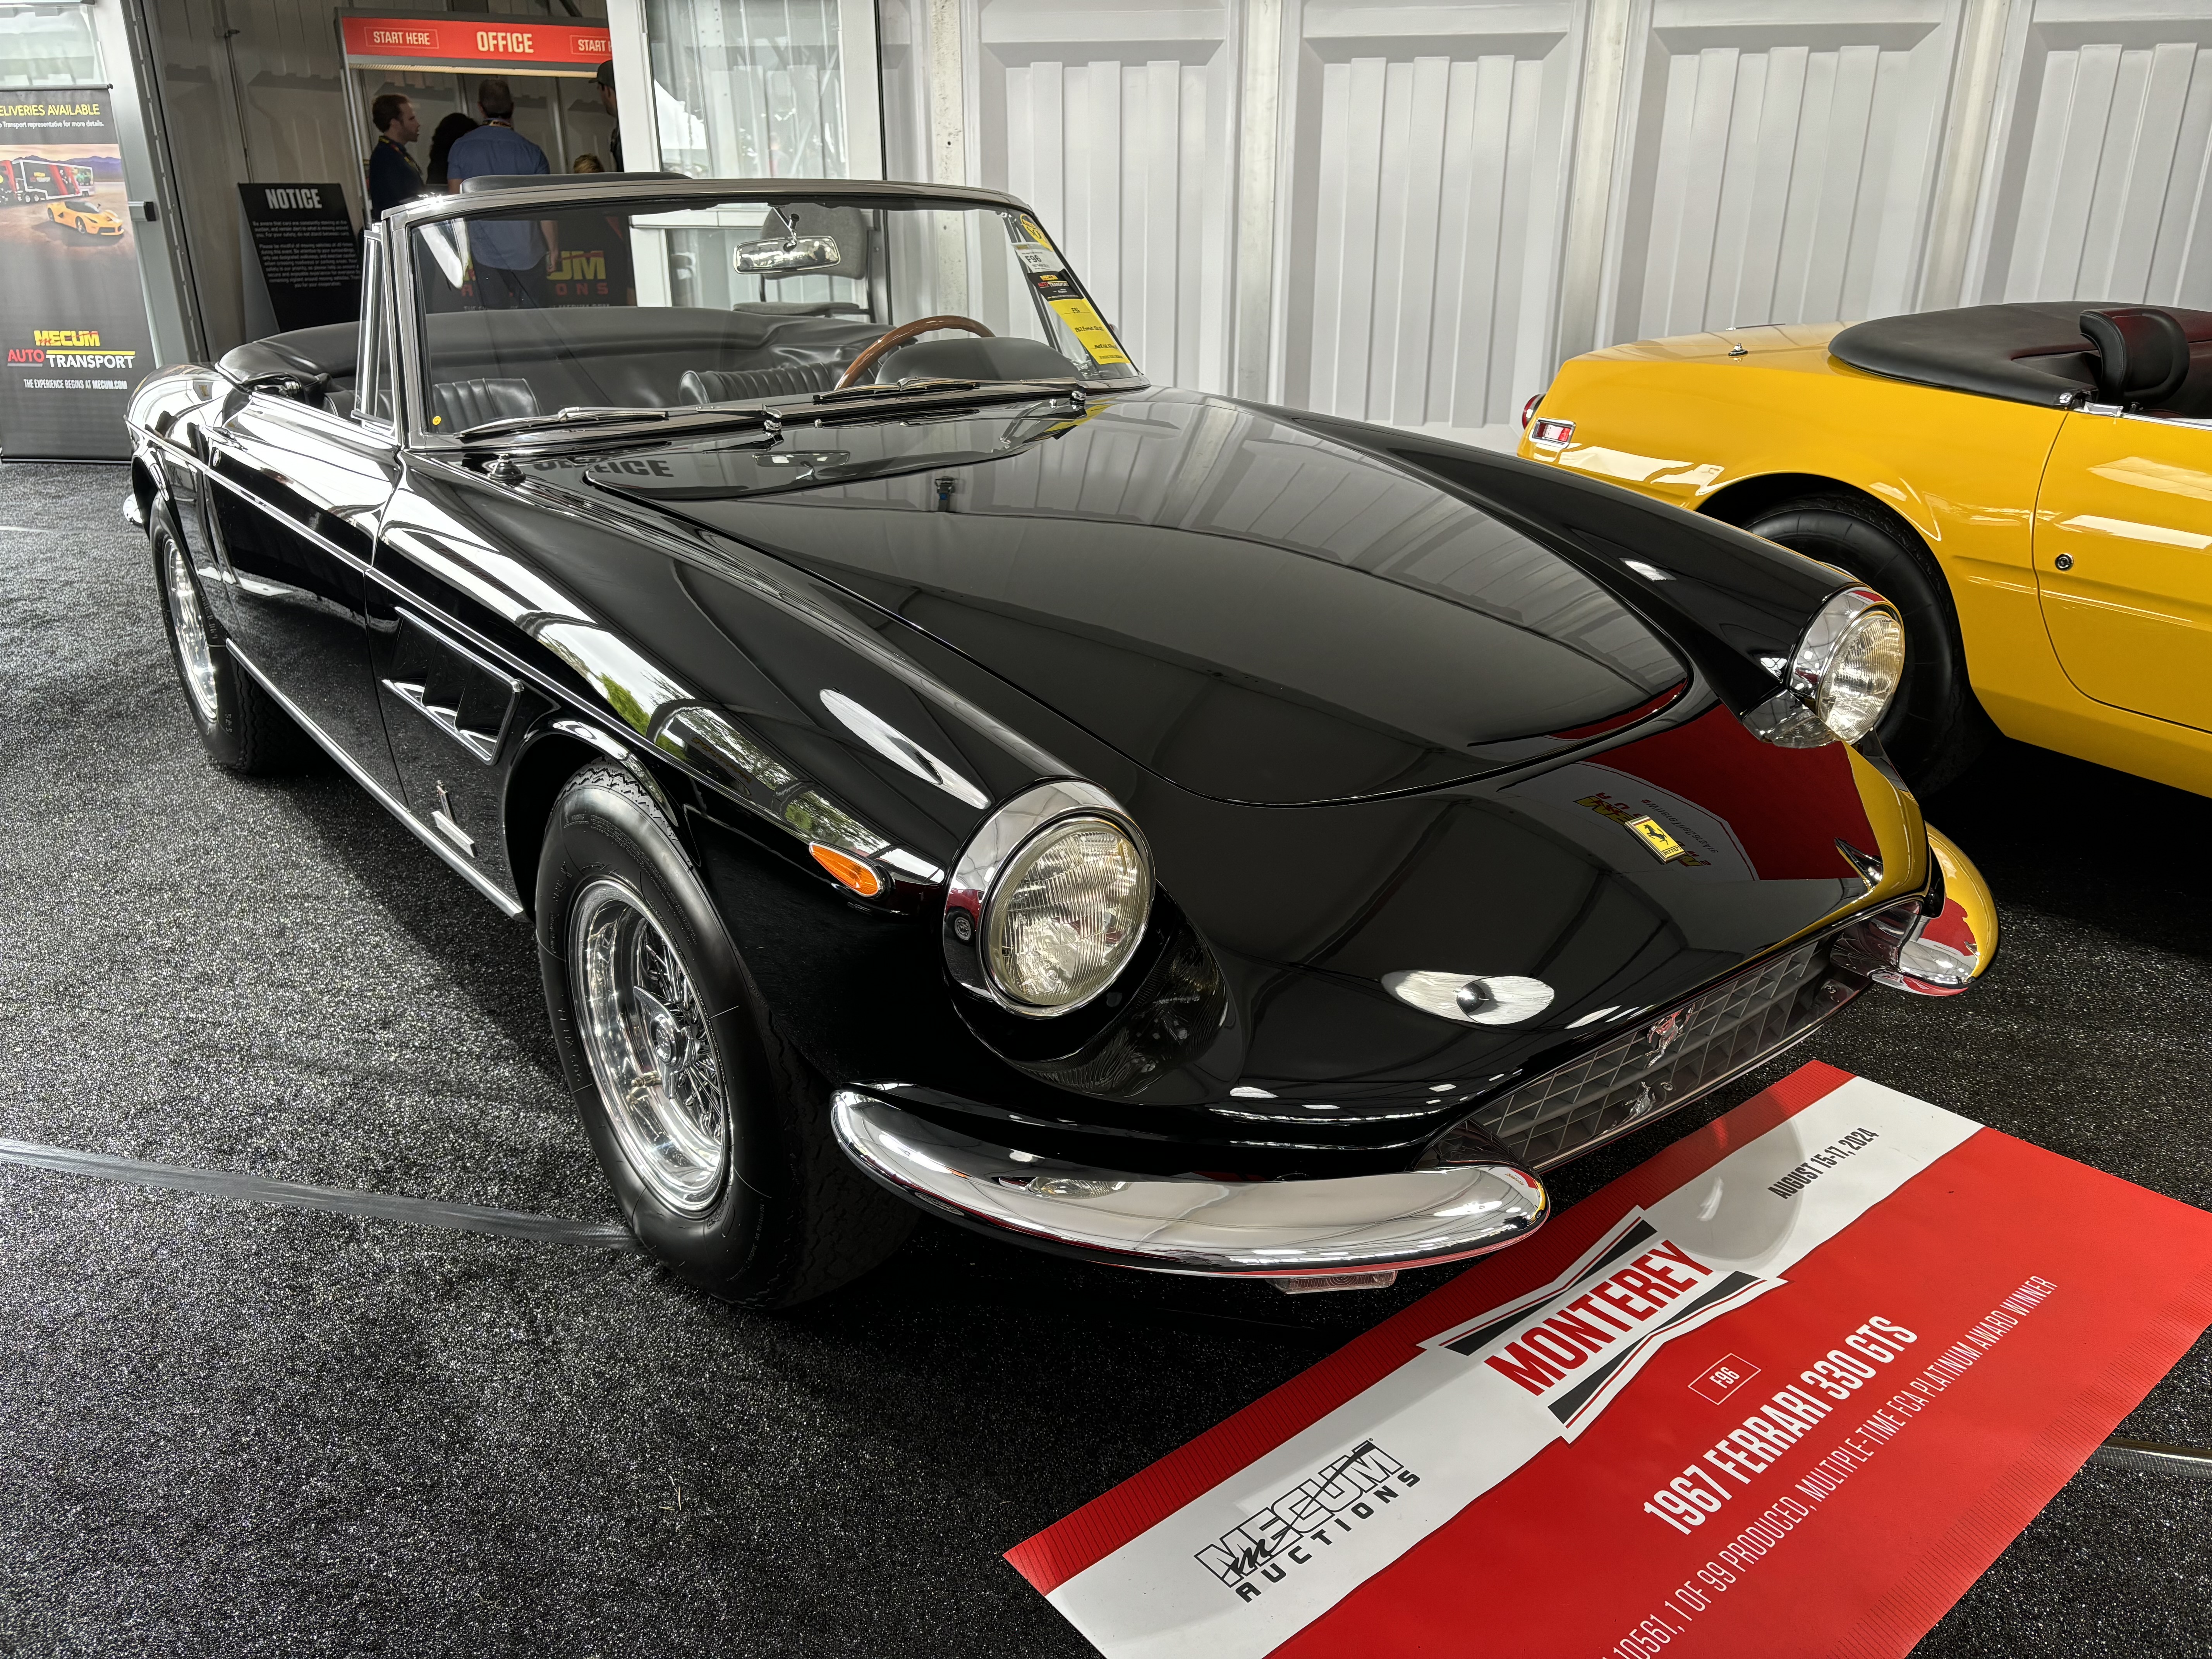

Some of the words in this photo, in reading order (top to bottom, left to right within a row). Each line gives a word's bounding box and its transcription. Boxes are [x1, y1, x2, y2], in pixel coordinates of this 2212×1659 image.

[373, 31, 404, 44] START
[406, 32, 431, 45] HERE
[477, 31, 534, 53] OFFICE
[578, 39, 606, 52] START
[48, 104, 100, 115] AVAILABLE
[265, 189, 323, 209] NOTICE
[1025, 254, 1042, 263] F96
[34, 330, 100, 347] MECUM
[7, 349, 45, 362] AUTO
[46, 354, 135, 368] TRANSPORT
[23, 379, 34, 388] THE
[34, 379, 64, 388] EXPERIENCE
[85, 380, 91, 388] AT
[1663, 845, 1682, 855] Ferrari
[1767, 1162, 1824, 1199] AUGUST
[1810, 1146, 1856, 1168] 15-17,
[1838, 1127, 1880, 1151] 2024
[1999, 1276, 2058, 1316] WINNER
[1484, 1240, 1713, 1396] MONTEREY
[1965, 1310, 2019, 1350] AWARD
[1709, 1367, 1740, 1389] F96
[1910, 1341, 1983, 1398] PLATINUM
[1886, 1390, 1930, 1418] FCA
[1643, 1464, 1733, 1535] 1967
[1702, 1384, 1834, 1484] FERRARI
[1800, 1350, 1877, 1400] 330
[1845, 1316, 1918, 1363] GTS
[1795, 1408, 1906, 1502] MULTIPLE-TIME
[1194, 1440, 1405, 1588] MECUM
[1235, 1470, 1420, 1603] AUCTIONS
[1719, 1496, 1817, 1572] PRODUCED,
[1697, 1562, 1736, 1592] 99
[1675, 1580, 1712, 1611] OF
[1665, 1601, 1693, 1621] 1
